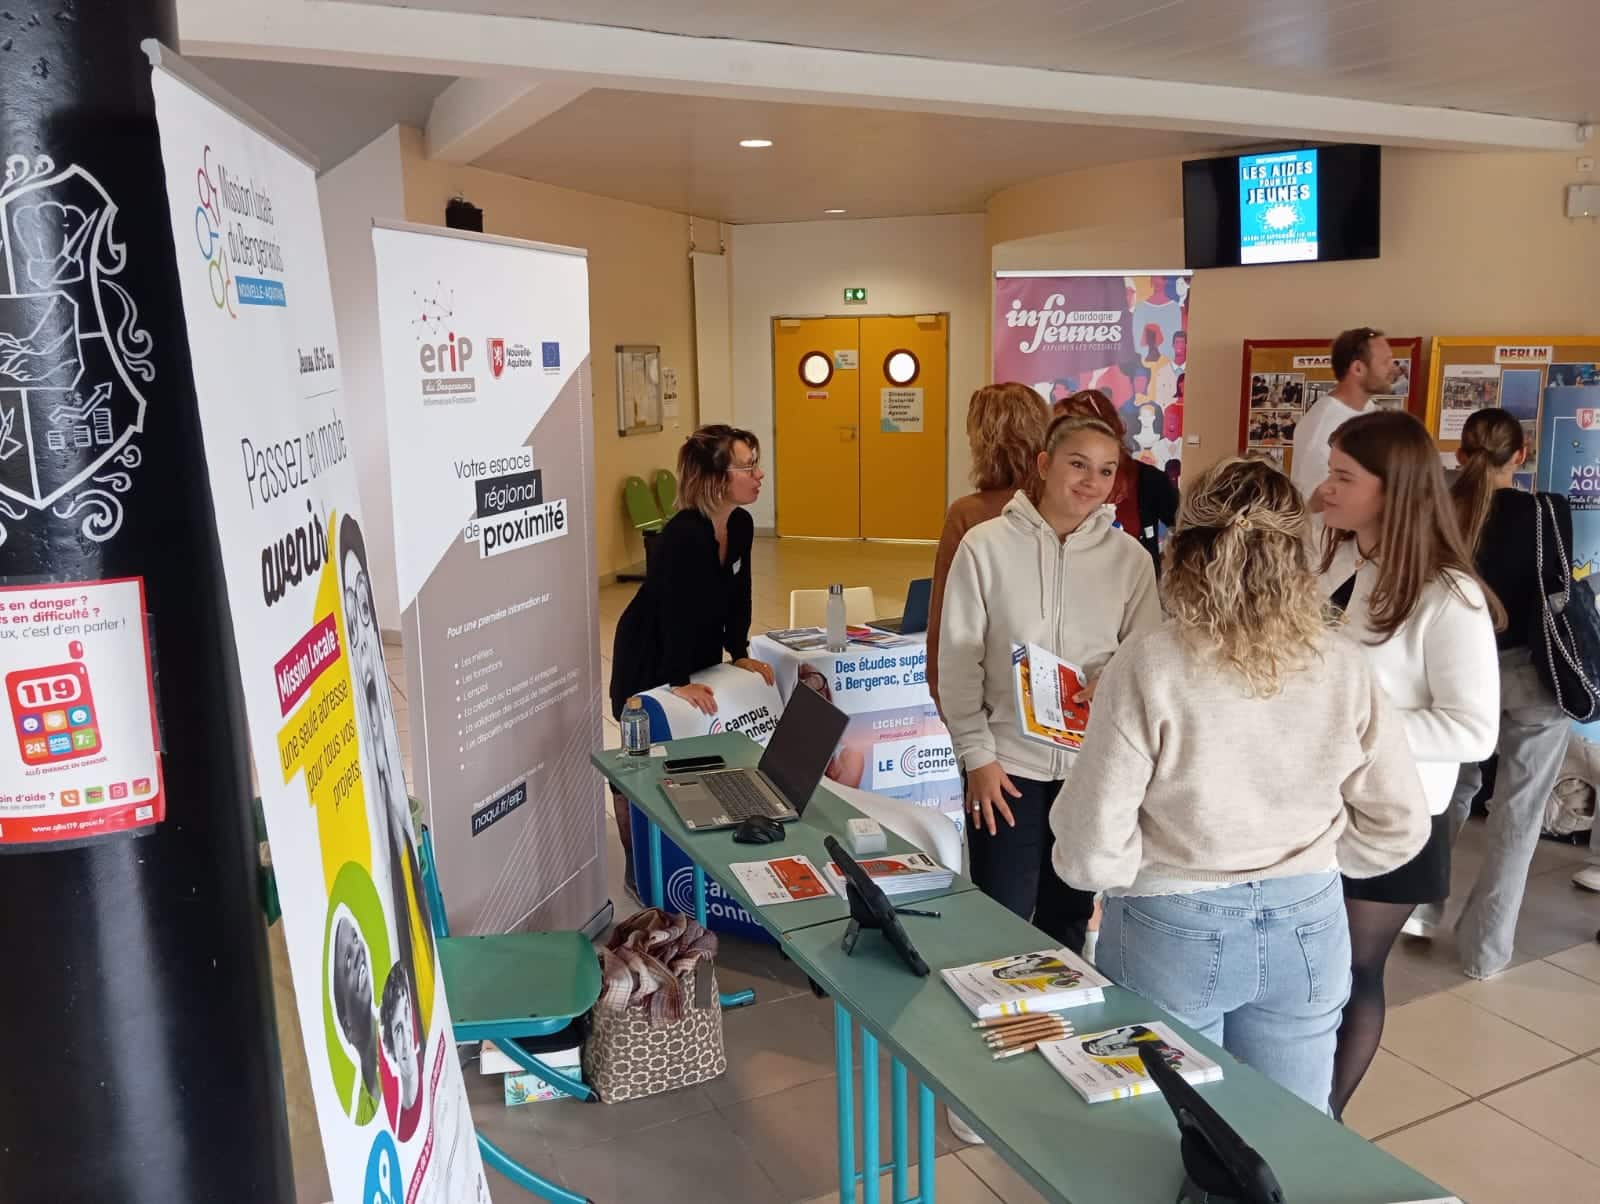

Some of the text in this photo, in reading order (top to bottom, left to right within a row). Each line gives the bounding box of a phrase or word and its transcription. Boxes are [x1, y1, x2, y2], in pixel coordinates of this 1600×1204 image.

[1242, 161, 1313, 180] LES AIDES
[1247, 184, 1311, 205] JEUNES
[1073, 311, 1113, 323] Dordogne
[1500, 348, 1548, 358] BERLIN
[241, 408, 347, 510] Passez en mode
[454, 454, 531, 479] Votre espace
[484, 478, 537, 511] régional
[465, 501, 565, 556] de proximité
[9, 602, 25, 611] en
[29, 599, 77, 611] danger
[80, 595, 88, 605] ?
[12, 615, 29, 624] en
[33, 608, 89, 623] difficulté
[92, 607, 100, 617] ?
[22, 626, 49, 638] c'est
[53, 623, 80, 636] d'en
[84, 618, 119, 636] parler
[278, 627, 337, 703] Mission Locale
[835, 659, 856, 674] Des
[859, 655, 897, 671] études
[21, 678, 76, 704] 119
[835, 680, 842, 692] à
[845, 674, 900, 693] Bergerac,
[281, 679, 349, 770] une seule adresse
[725, 704, 770, 732] campus
[745, 715, 780, 738] nnecté
[307, 718, 356, 800] pour tous vos
[879, 759, 894, 773] LE
